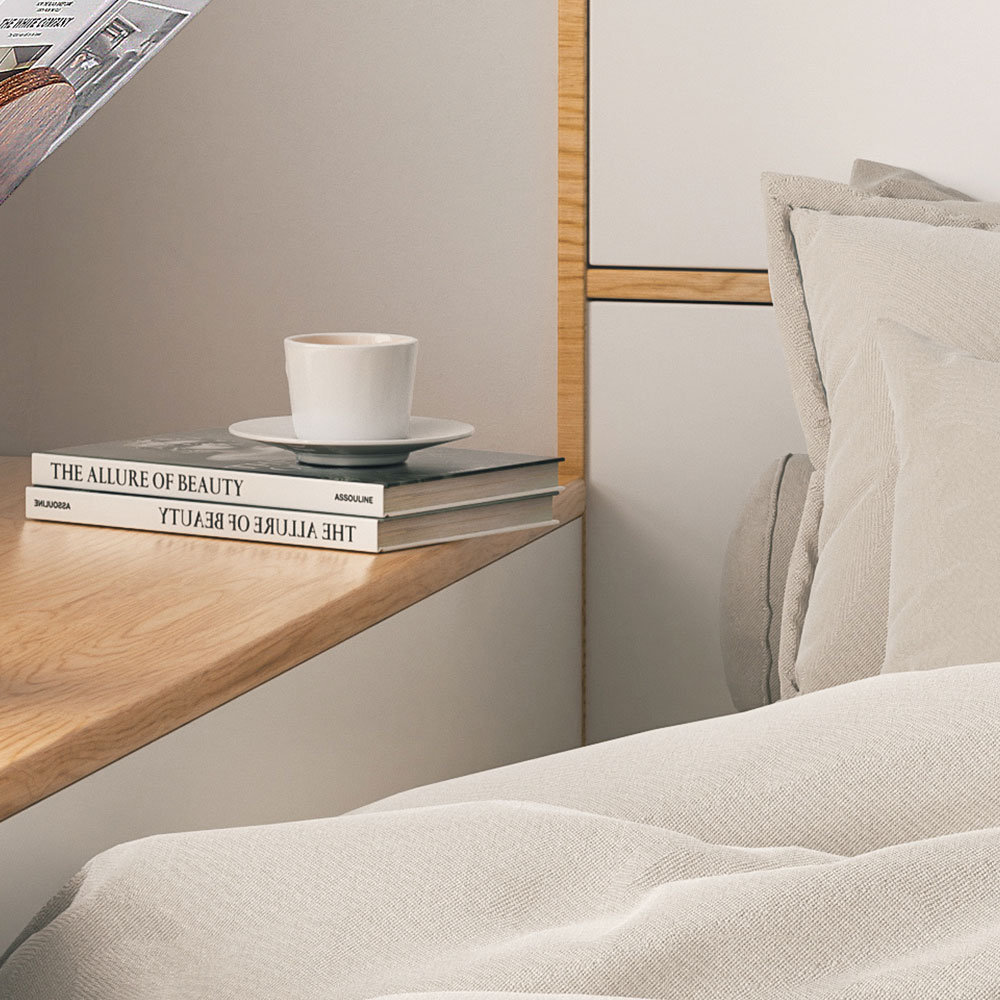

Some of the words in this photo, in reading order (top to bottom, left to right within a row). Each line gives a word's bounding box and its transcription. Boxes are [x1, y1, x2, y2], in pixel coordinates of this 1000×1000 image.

[50, 462, 84, 482] THE
[87, 466, 149, 489] ALLURE
[152, 472, 174, 490] OF
[178, 474, 244, 497] BEAUTY
[334, 493, 374, 505] ASSOULINE
